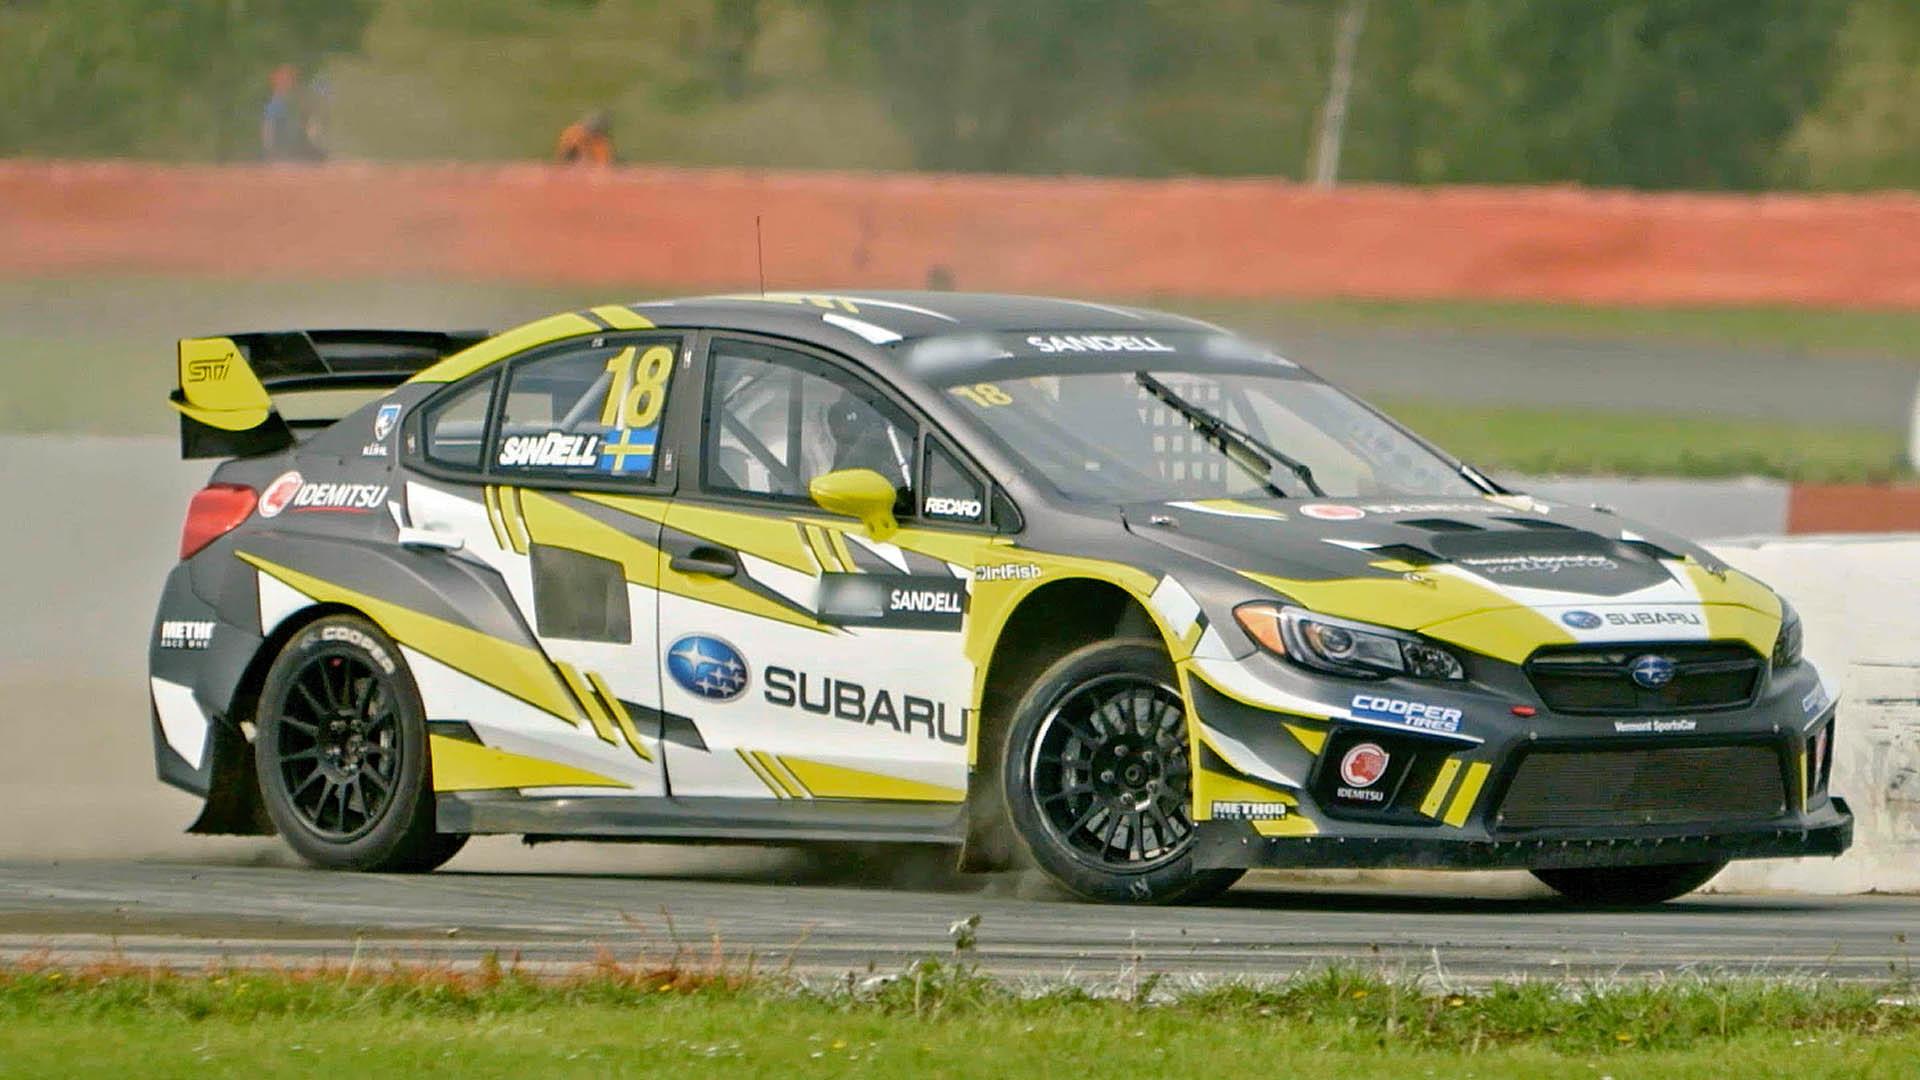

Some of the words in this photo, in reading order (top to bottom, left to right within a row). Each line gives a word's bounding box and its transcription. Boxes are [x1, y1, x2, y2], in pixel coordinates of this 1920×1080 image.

[1026, 336, 1176, 353] SANDELL
[600, 346, 674, 428] 18
[949, 383, 1013, 407] 18
[500, 432, 599, 466] SANDELL
[295, 484, 389, 508] IDEMITSU
[925, 497, 982, 517] RECARO
[891, 589, 961, 613] SANDELL
[1605, 612, 1702, 625] SUBARU
[321, 627, 396, 674] COOPER
[764, 665, 968, 746] SUBARU
[1352, 694, 1462, 721] COOPER
[1404, 717, 1459, 732] TIRES
[1337, 787, 1384, 801] IDEMITSU
[1213, 802, 1287, 815] METHOD
